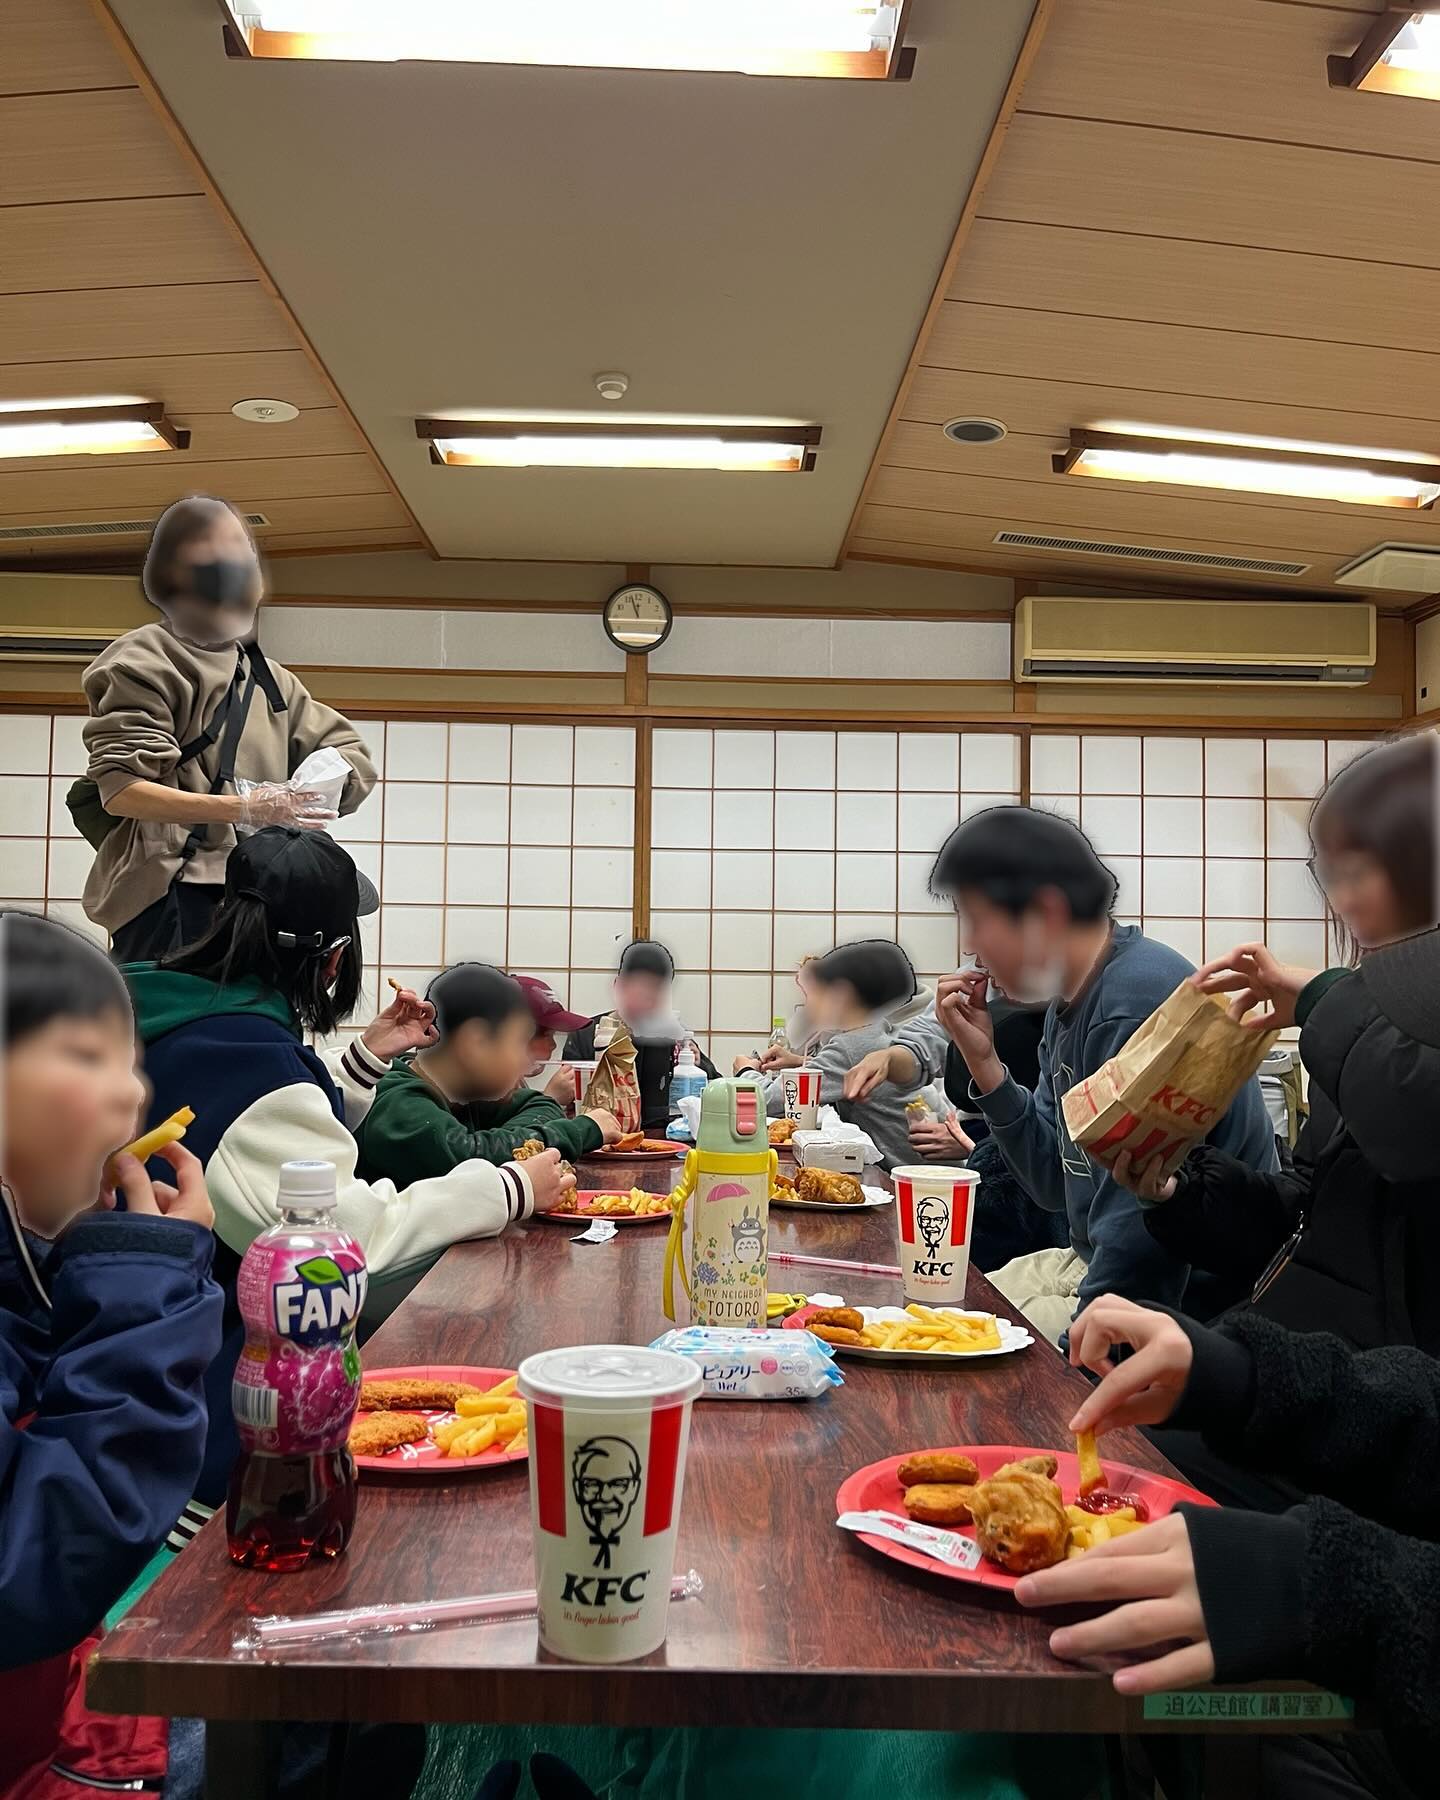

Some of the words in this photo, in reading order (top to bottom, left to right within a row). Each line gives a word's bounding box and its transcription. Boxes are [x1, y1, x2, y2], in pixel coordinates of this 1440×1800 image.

[1152, 1085, 1216, 1125] KFC
[912, 1260, 954, 1277] KFC
[704, 1288, 718, 1299] MY
[721, 1288, 763, 1300] NEIGHBOR
[708, 1300, 760, 1318] TOTORO
[702, 1362, 760, 1381] ピュアリー
[560, 1571, 648, 1607] KFC
